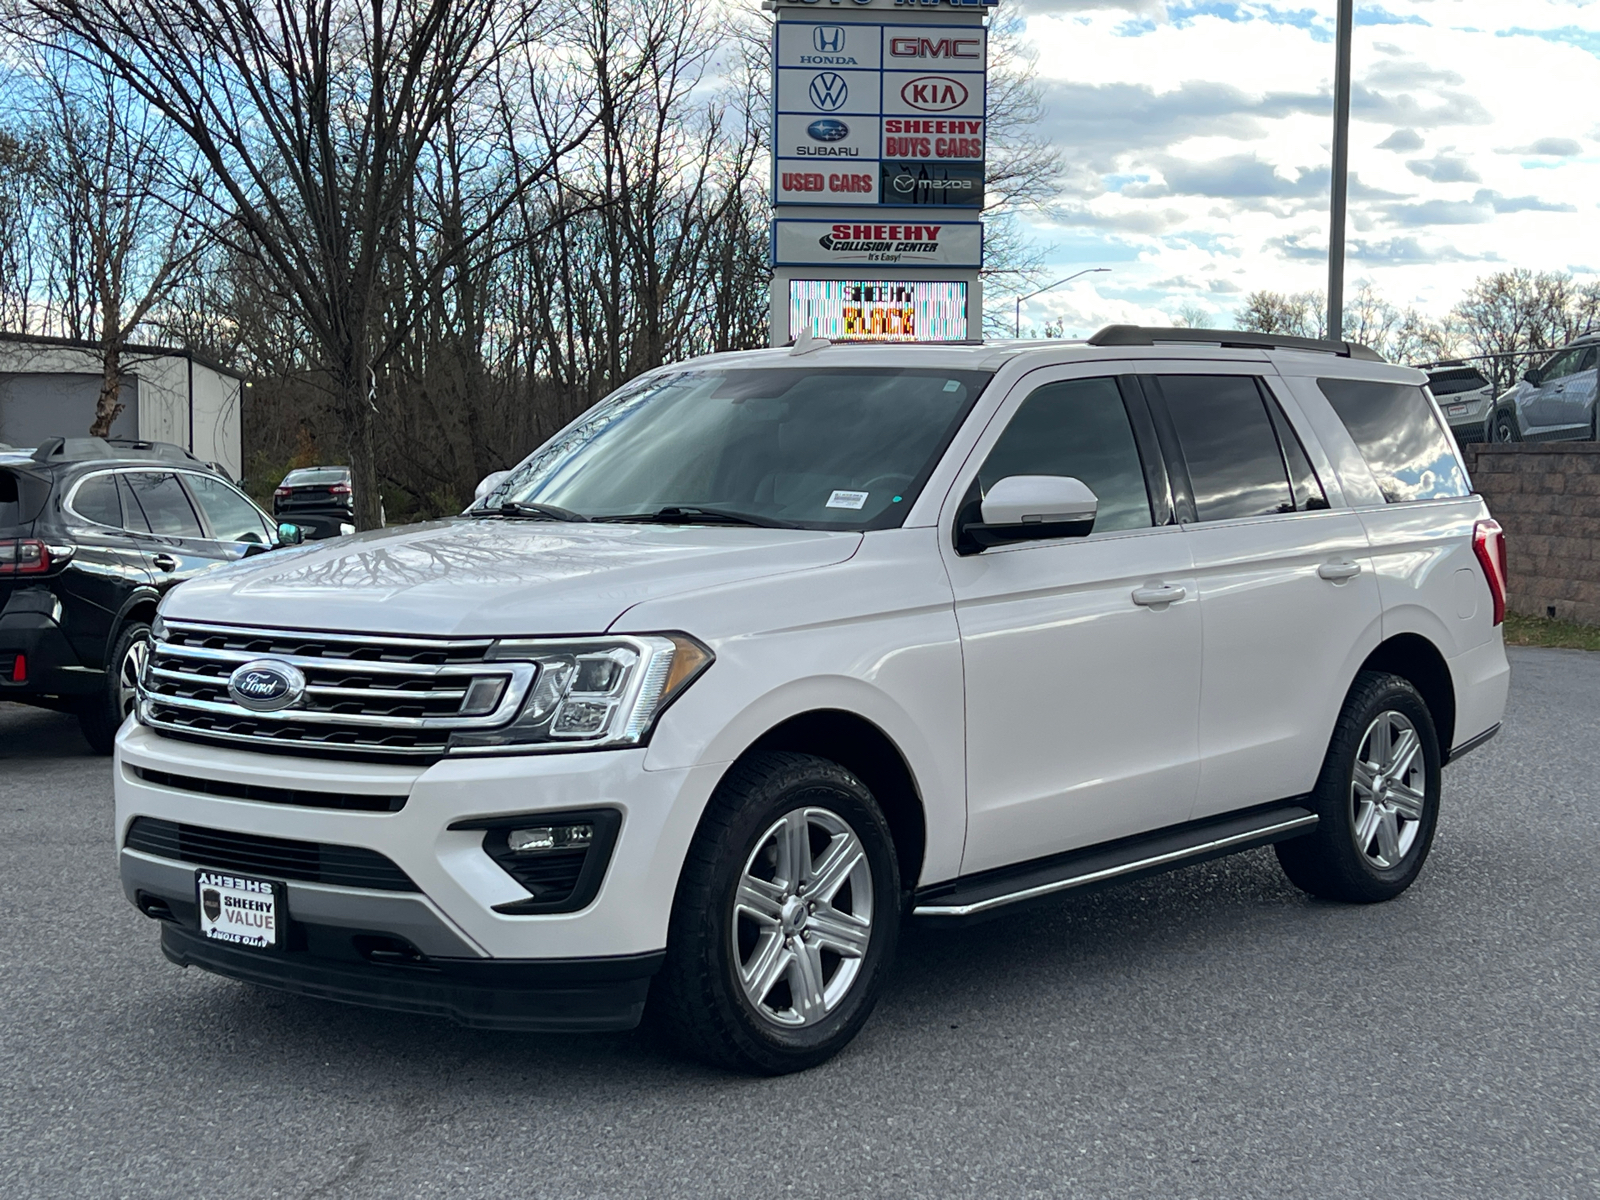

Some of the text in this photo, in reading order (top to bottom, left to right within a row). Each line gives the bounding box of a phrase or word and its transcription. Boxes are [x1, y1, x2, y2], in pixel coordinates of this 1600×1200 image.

[890, 36, 980, 59] GMC
[800, 55, 858, 65] HONDA
[912, 84, 957, 104] KIA
[885, 120, 982, 134] SHEEHY
[796, 146, 859, 156] SUBARU
[885, 136, 981, 158] BUYS CARS
[782, 172, 873, 193] USED CARS
[832, 224, 942, 241] SHEEHY
[832, 241, 939, 252] COLLISION CENTER
[868, 253, 902, 263] It's Easy!
[241, 672, 278, 695] Ford
[198, 872, 272, 894] SHEEHY
[224, 896, 272, 913] SHEEHY
[225, 908, 274, 929] VALUE
